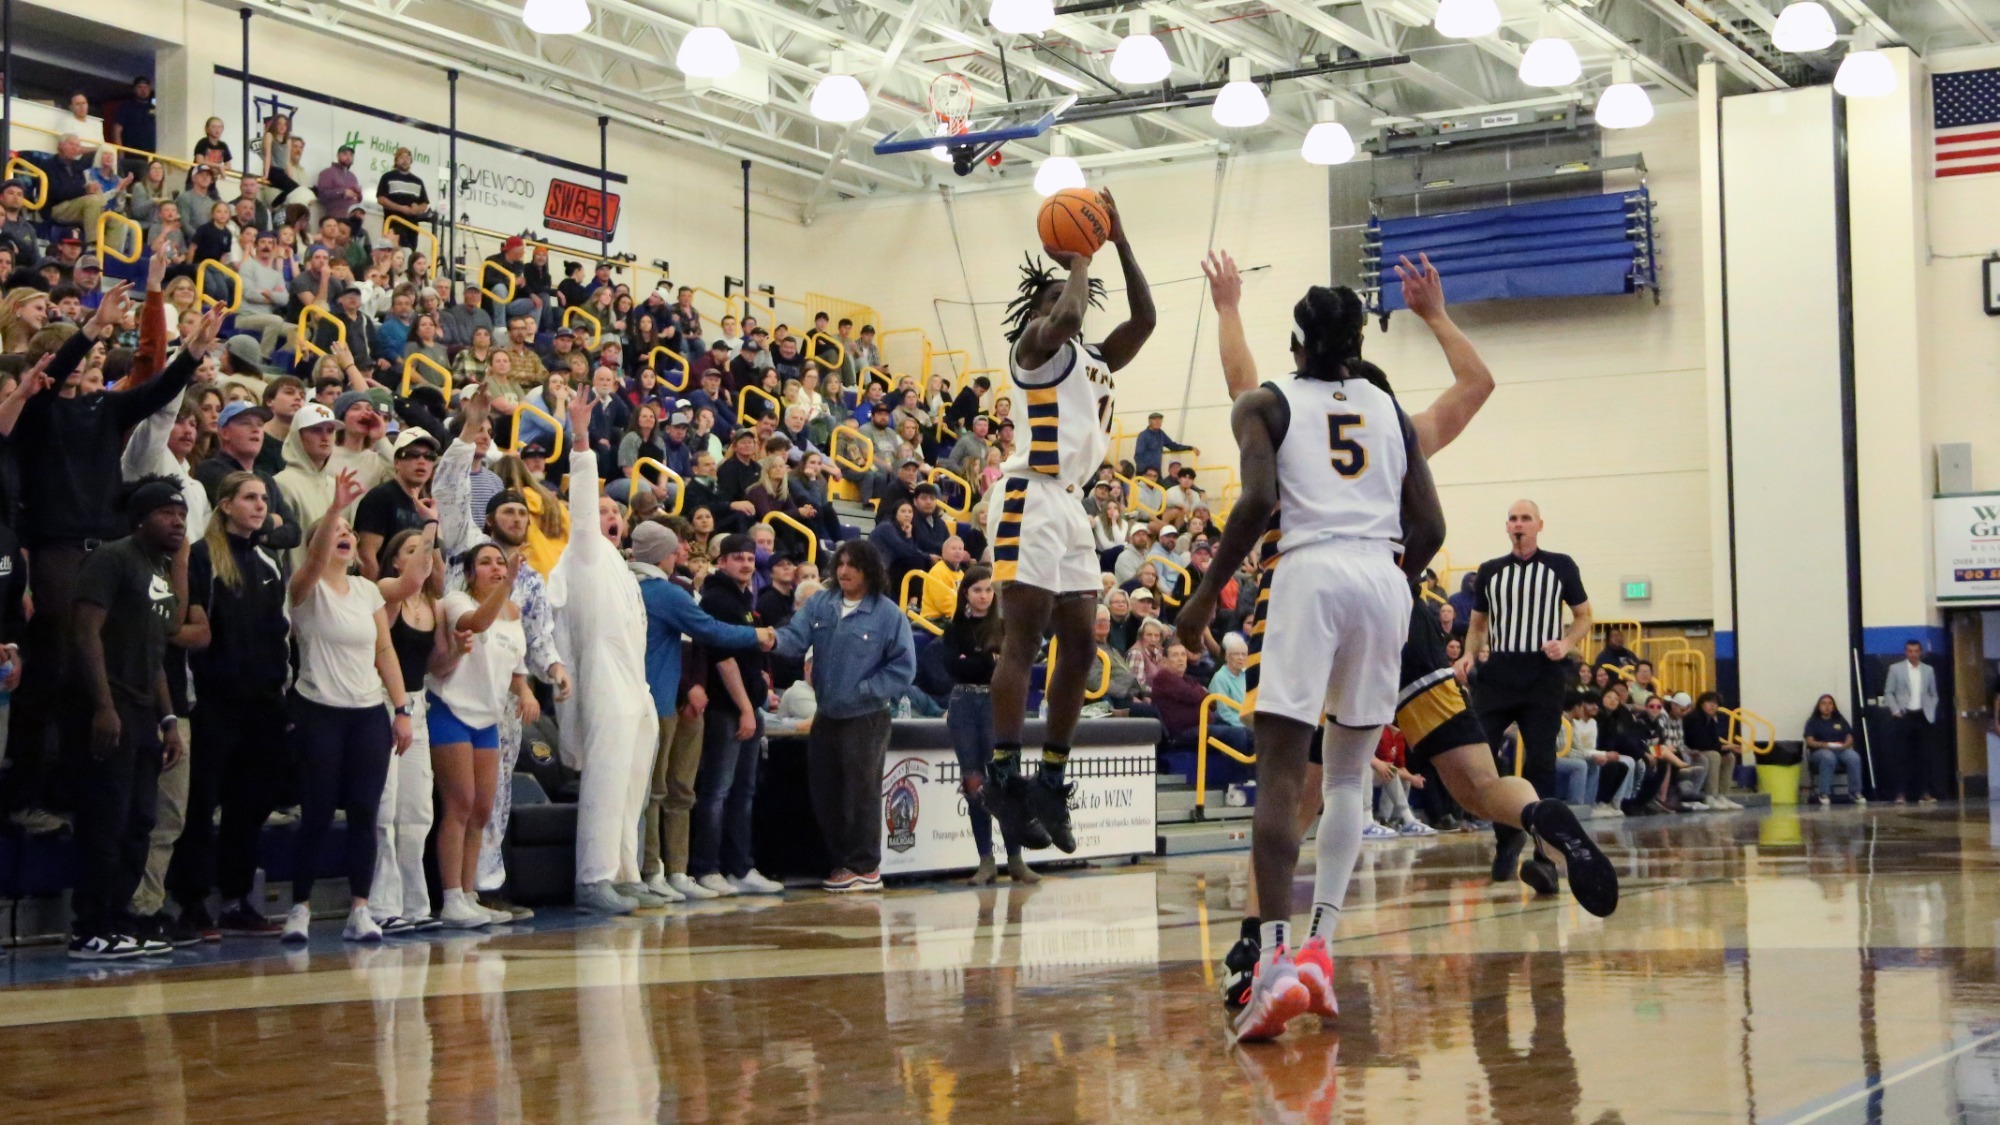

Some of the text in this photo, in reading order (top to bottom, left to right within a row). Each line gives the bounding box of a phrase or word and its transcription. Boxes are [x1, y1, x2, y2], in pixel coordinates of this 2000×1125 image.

[413, 146, 431, 165] Inn
[453, 162, 535, 199] OMEWOOD
[1326, 413, 1369, 480] 5
[1627, 582, 1646, 599] EXIT
[1090, 792, 1101, 809] to
[1104, 788, 1133, 808] WIN!
[932, 829, 959, 842] Durango
